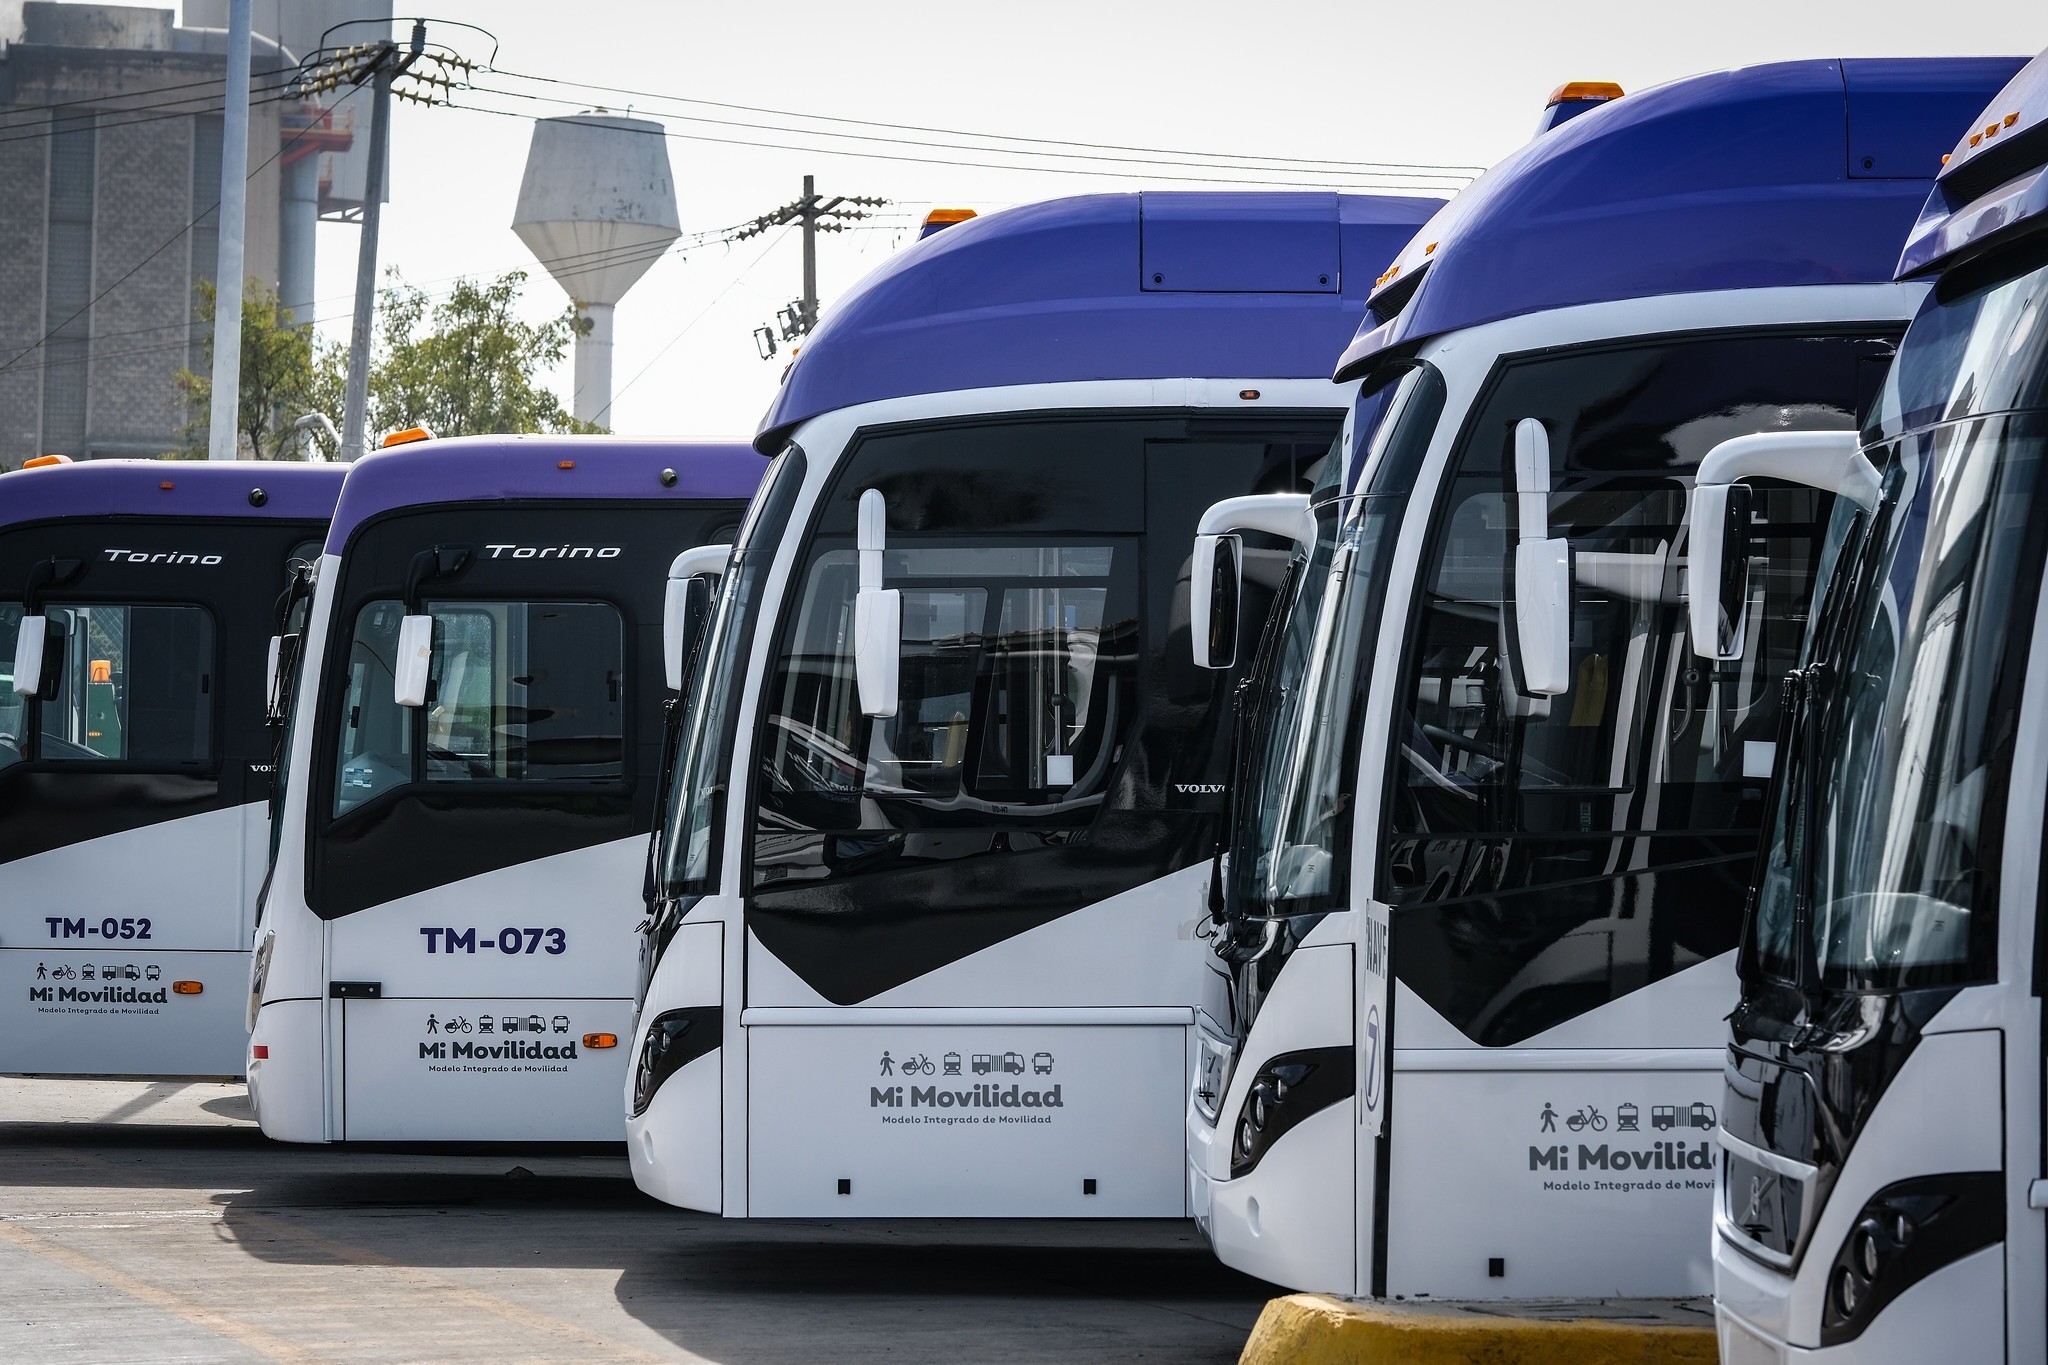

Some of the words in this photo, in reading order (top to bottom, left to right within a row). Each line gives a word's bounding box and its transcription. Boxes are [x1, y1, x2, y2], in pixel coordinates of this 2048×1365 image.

[104, 549, 223, 565] Torino
[485, 543, 622, 558] Torino
[45, 917, 152, 940] TM-052
[419, 927, 567, 955] TM-073
[29, 986, 54, 1002] Mi
[58, 985, 168, 1004] Movilidad
[67, 1007, 108, 1016] Integrado
[121, 1007, 159, 1015] Movilidad
[419, 1041, 446, 1059] Mi
[452, 1040, 578, 1060] Movilidad
[428, 1065, 461, 1073] Modelo
[462, 1065, 509, 1074] Integrado
[511, 1065, 523, 1073] de
[524, 1065, 568, 1073] Movilidad
[870, 1085, 904, 1108] Mi
[910, 1083, 1064, 1108] Movilidad
[882, 1115, 921, 1124] Modelo
[923, 1115, 980, 1126] Integrado
[982, 1115, 996, 1124] de
[998, 1115, 1052, 1124] Movilidad
[1529, 1145, 1569, 1171] Mi
[1578, 1141, 1716, 1171] Movilid
[1543, 1181, 1591, 1191] Modelo
[1593, 1180, 1662, 1193] Integrado
[1665, 1180, 1682, 1190] de
[1685, 1179, 1715, 1190] Movi
